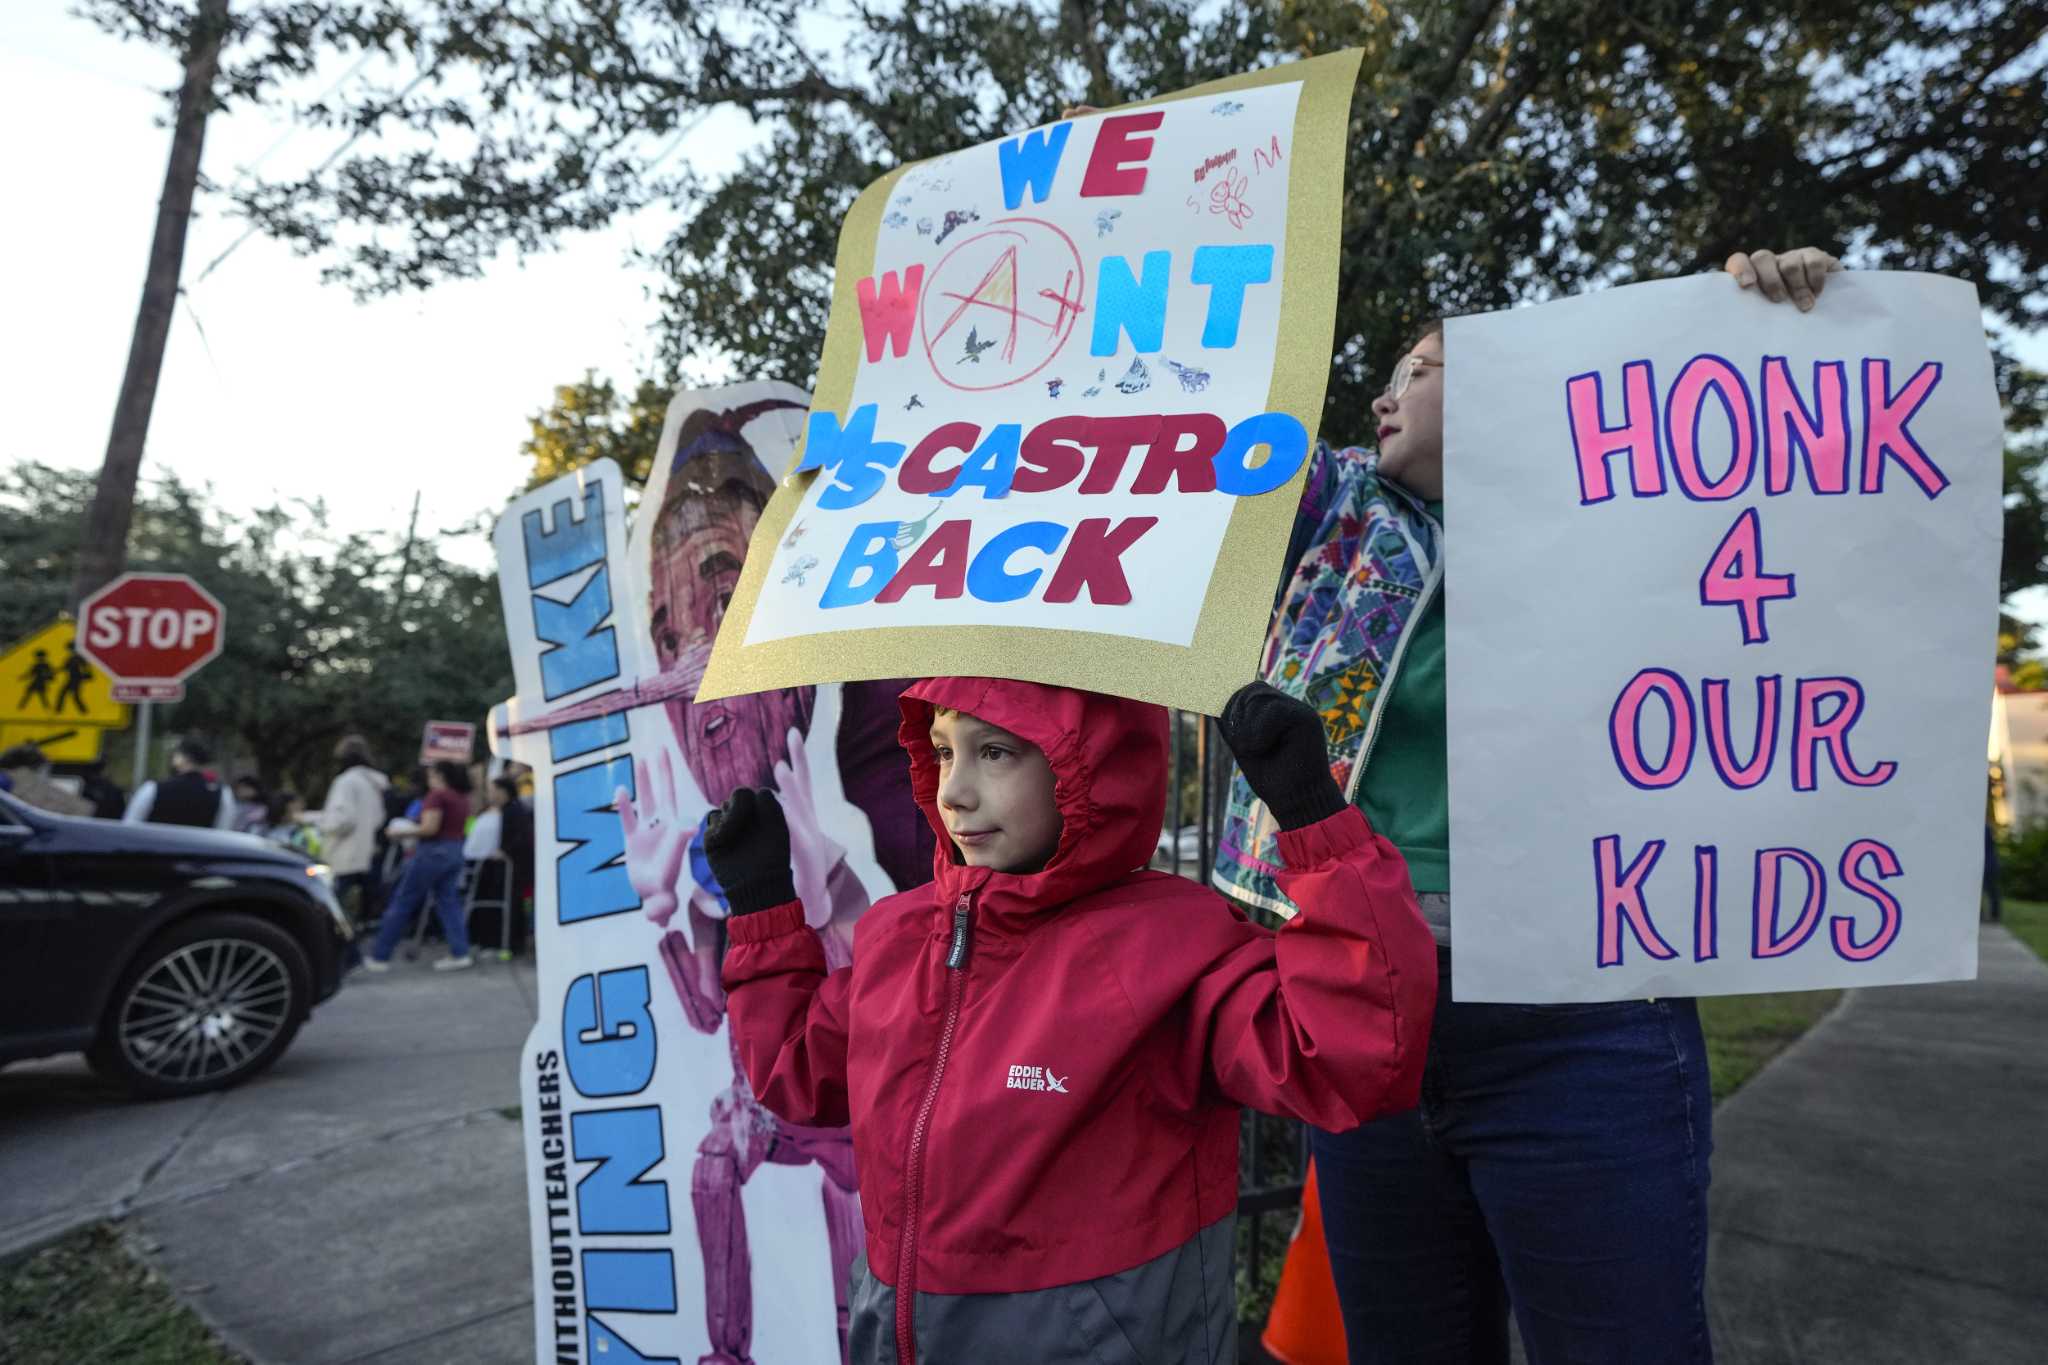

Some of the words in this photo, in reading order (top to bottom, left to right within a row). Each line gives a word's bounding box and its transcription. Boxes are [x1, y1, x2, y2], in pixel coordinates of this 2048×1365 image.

[999, 111, 1165, 210] WE
[897, 411, 1309, 499] CASTRO
[1566, 353, 1950, 505] HONK
[818, 515, 1160, 610] BACK
[1699, 506, 1797, 645] 4
[89, 606, 213, 649] STOP
[521, 478, 643, 926] MIKE
[1608, 667, 1898, 792] OUR
[1592, 834, 1904, 969] KIDS
[1006, 1077, 1045, 1091] BAUER
[1008, 1064, 1043, 1078] EDDIE
[550, 1222, 579, 1365] ITHOUT
